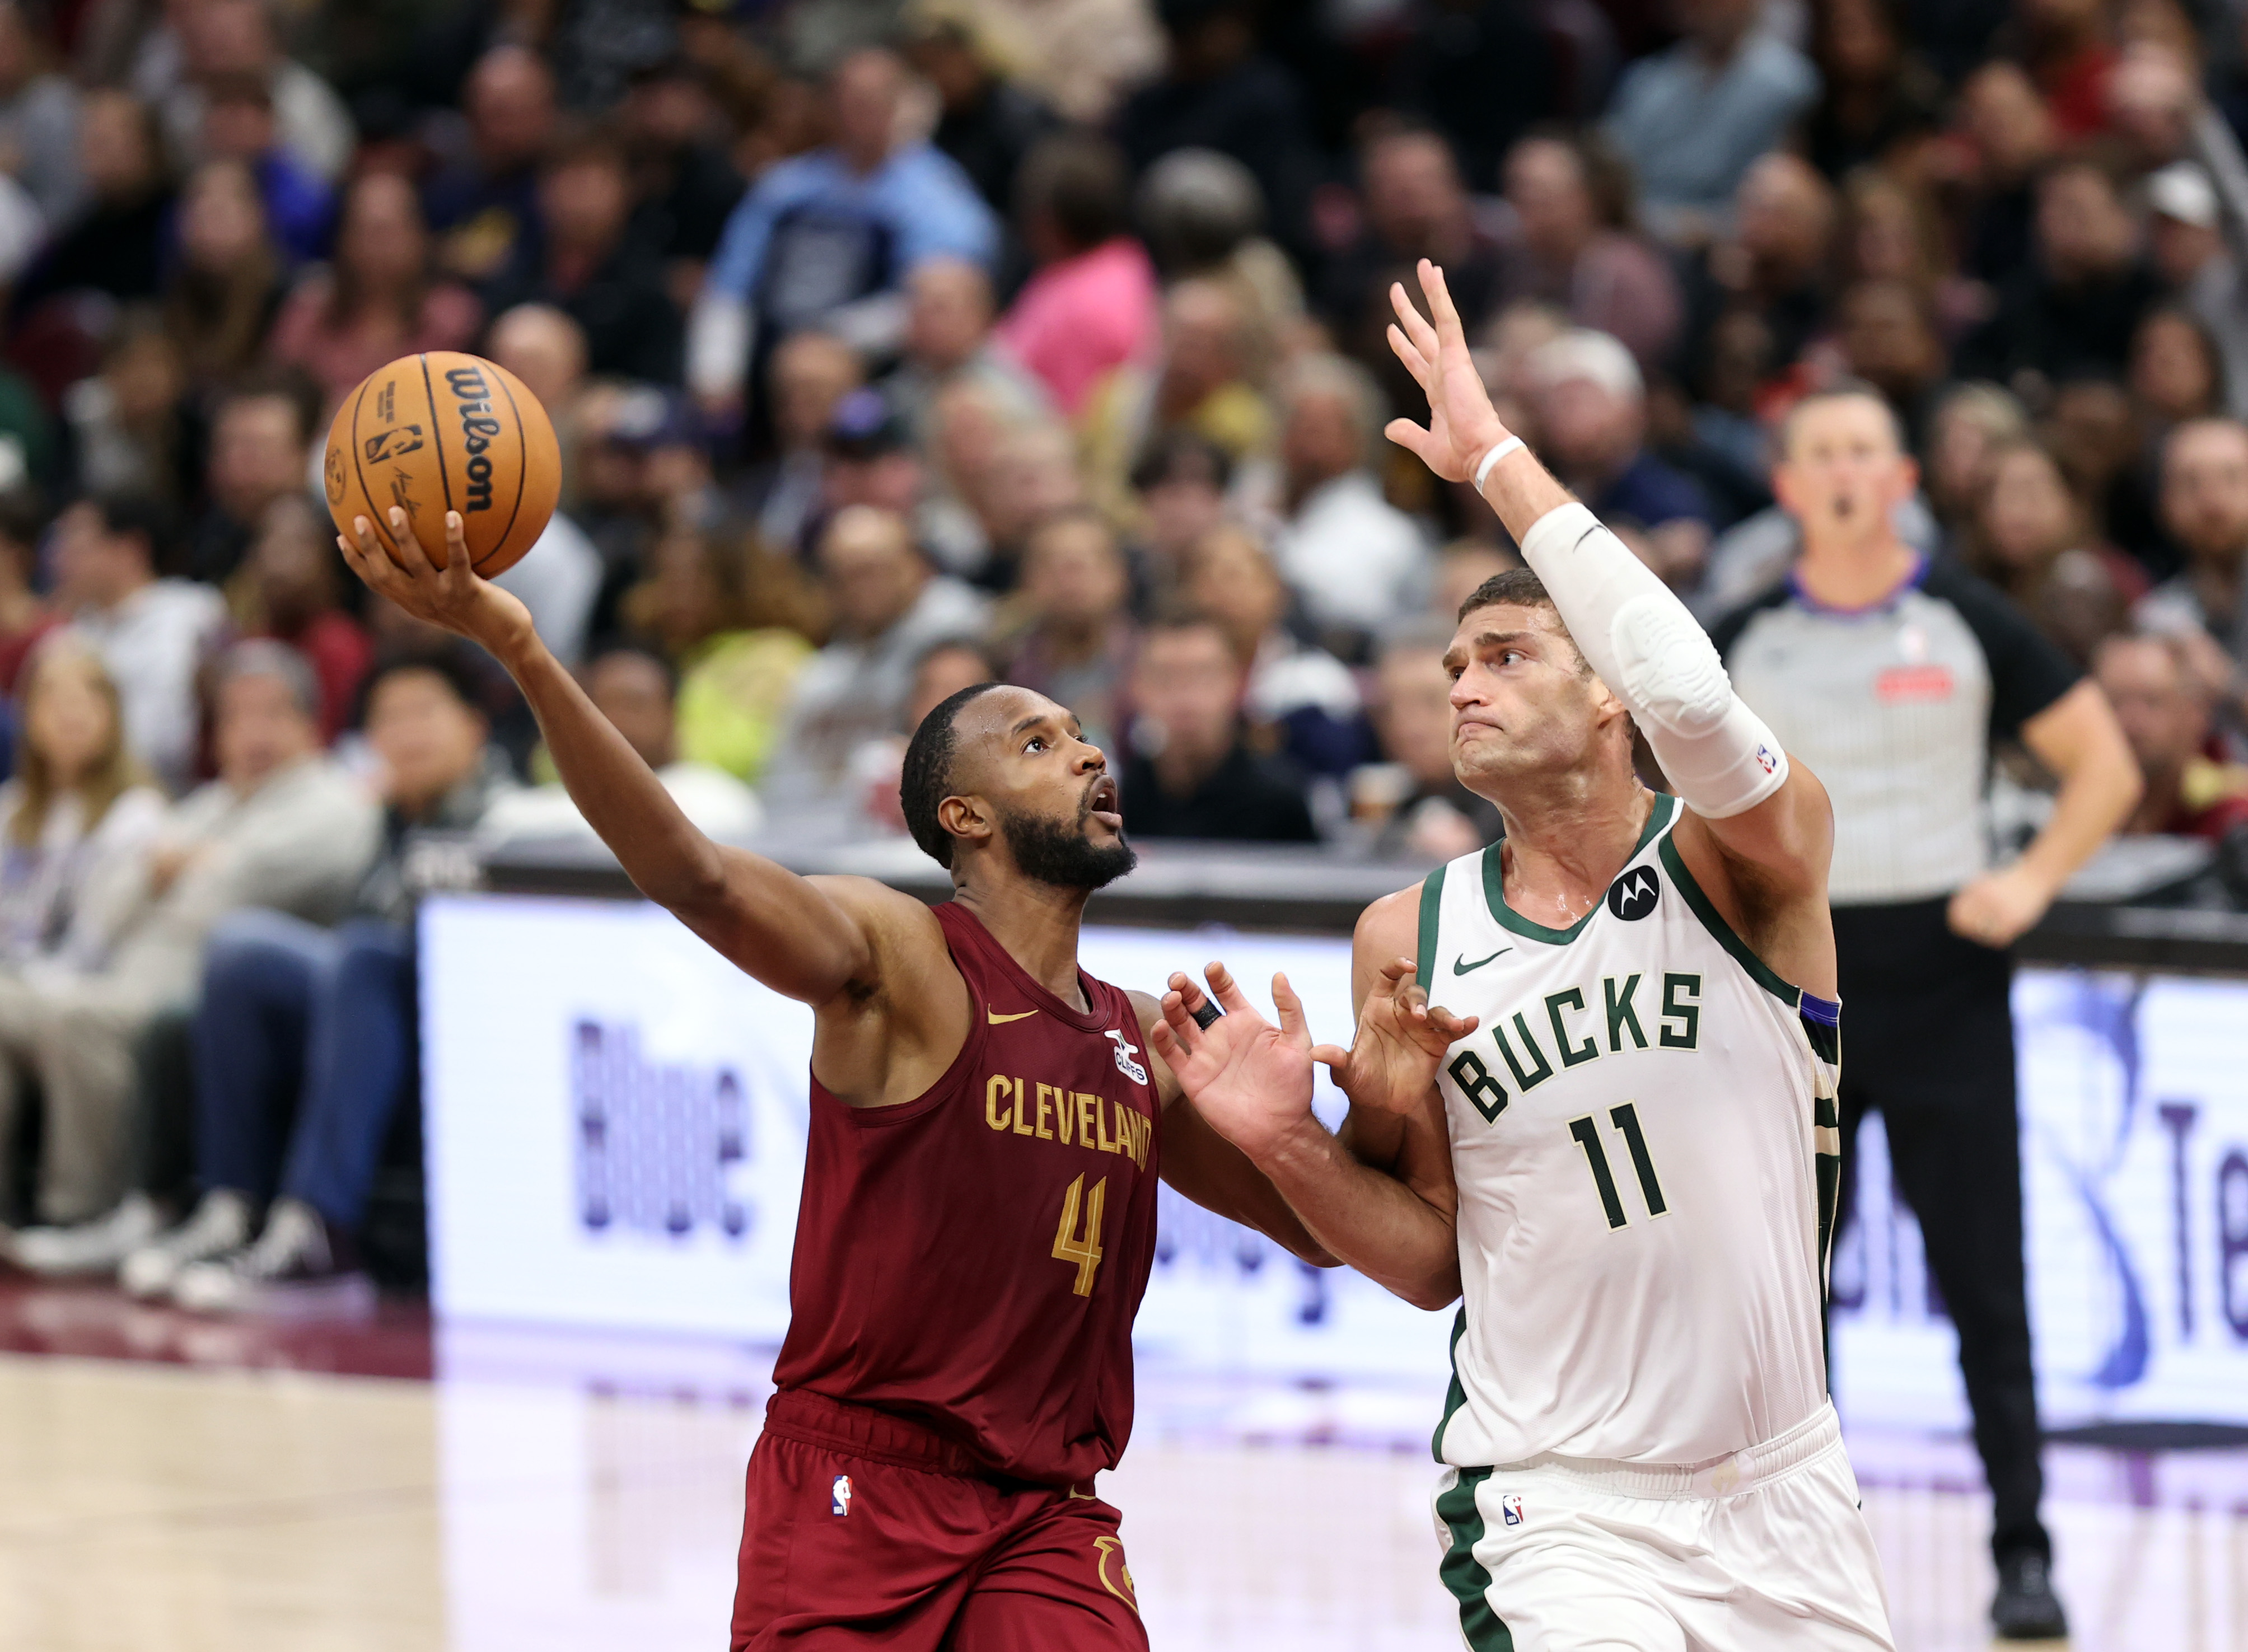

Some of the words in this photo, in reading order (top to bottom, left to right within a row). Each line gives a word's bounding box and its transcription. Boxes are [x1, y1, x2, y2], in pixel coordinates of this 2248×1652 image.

[445, 366, 501, 514] Wilson
[1116, 1051, 1145, 1081] CLIFFS
[1447, 970, 1703, 1128] BUCKS
[985, 1074, 1152, 1173] CLEVELAND
[1564, 1098, 1672, 1233] 11
[1051, 1172, 1106, 1297] 4
